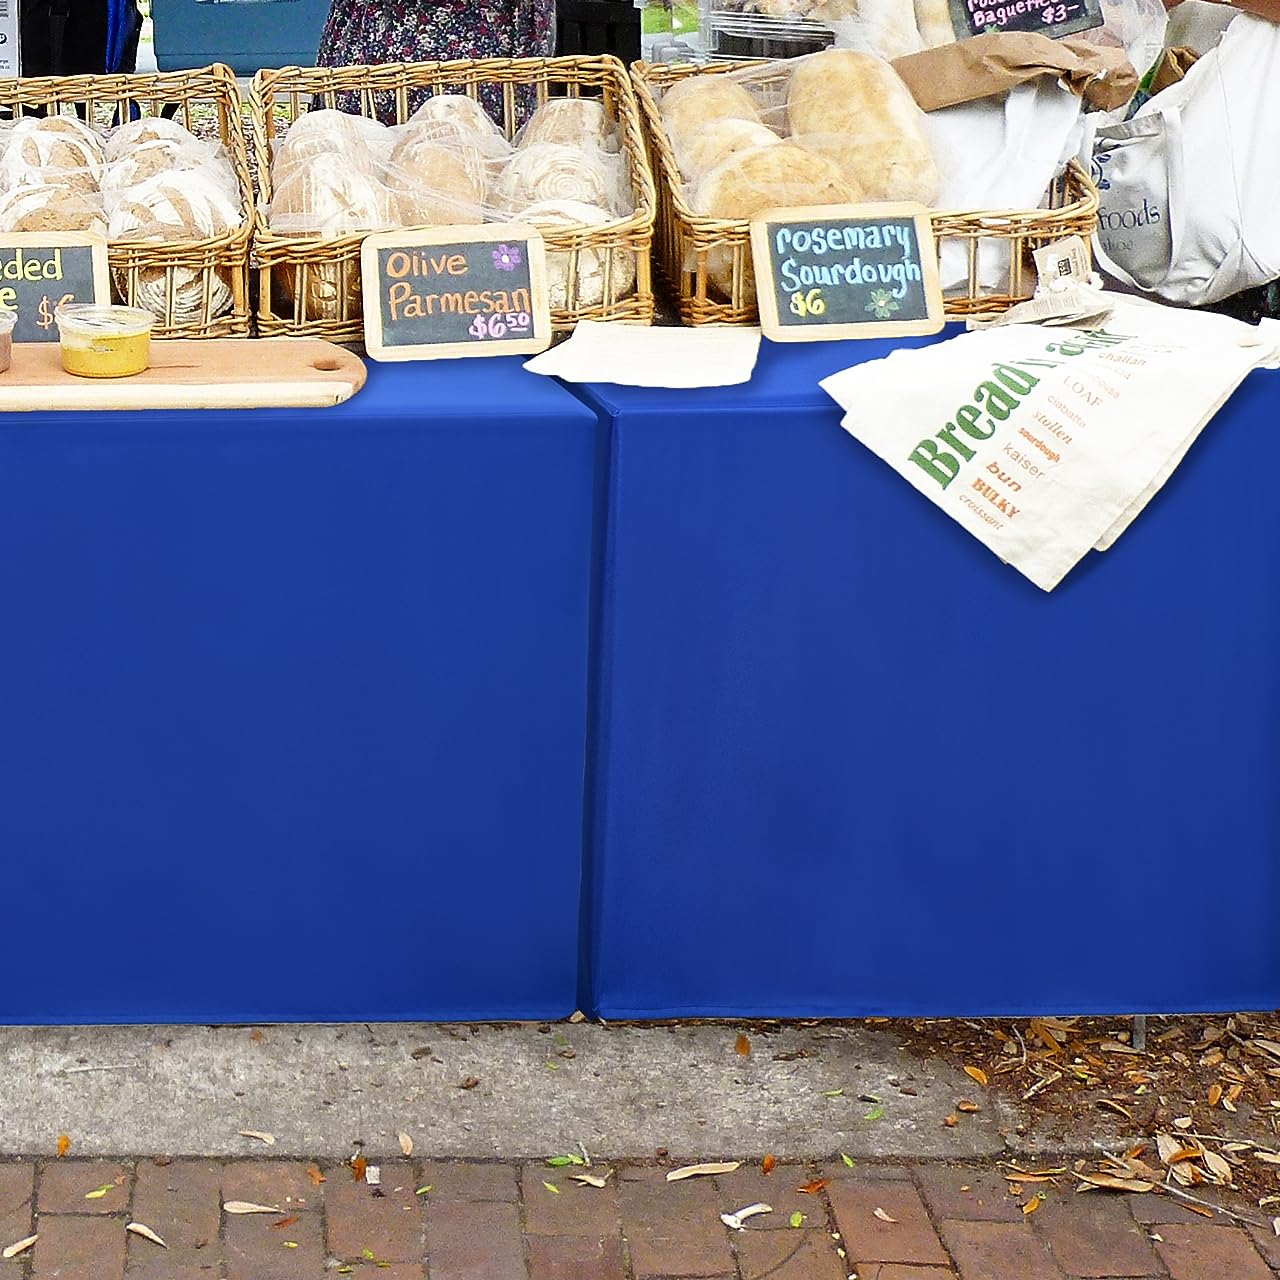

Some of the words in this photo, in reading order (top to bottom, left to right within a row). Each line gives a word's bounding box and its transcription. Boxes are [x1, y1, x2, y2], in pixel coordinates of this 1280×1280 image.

[386, 249, 469, 279] Olive
[388, 281, 532, 321] Parmesan
[789, 287, 826, 317] $6
[907, 362, 1041, 490] Bread
[1031, 410, 1073, 445] stollen
[1002, 442, 1046, 479] kaiser
[1017, 427, 1061, 463] sourdough
[985, 461, 1022, 492] bun
[971, 477, 1020, 519] BULKY
